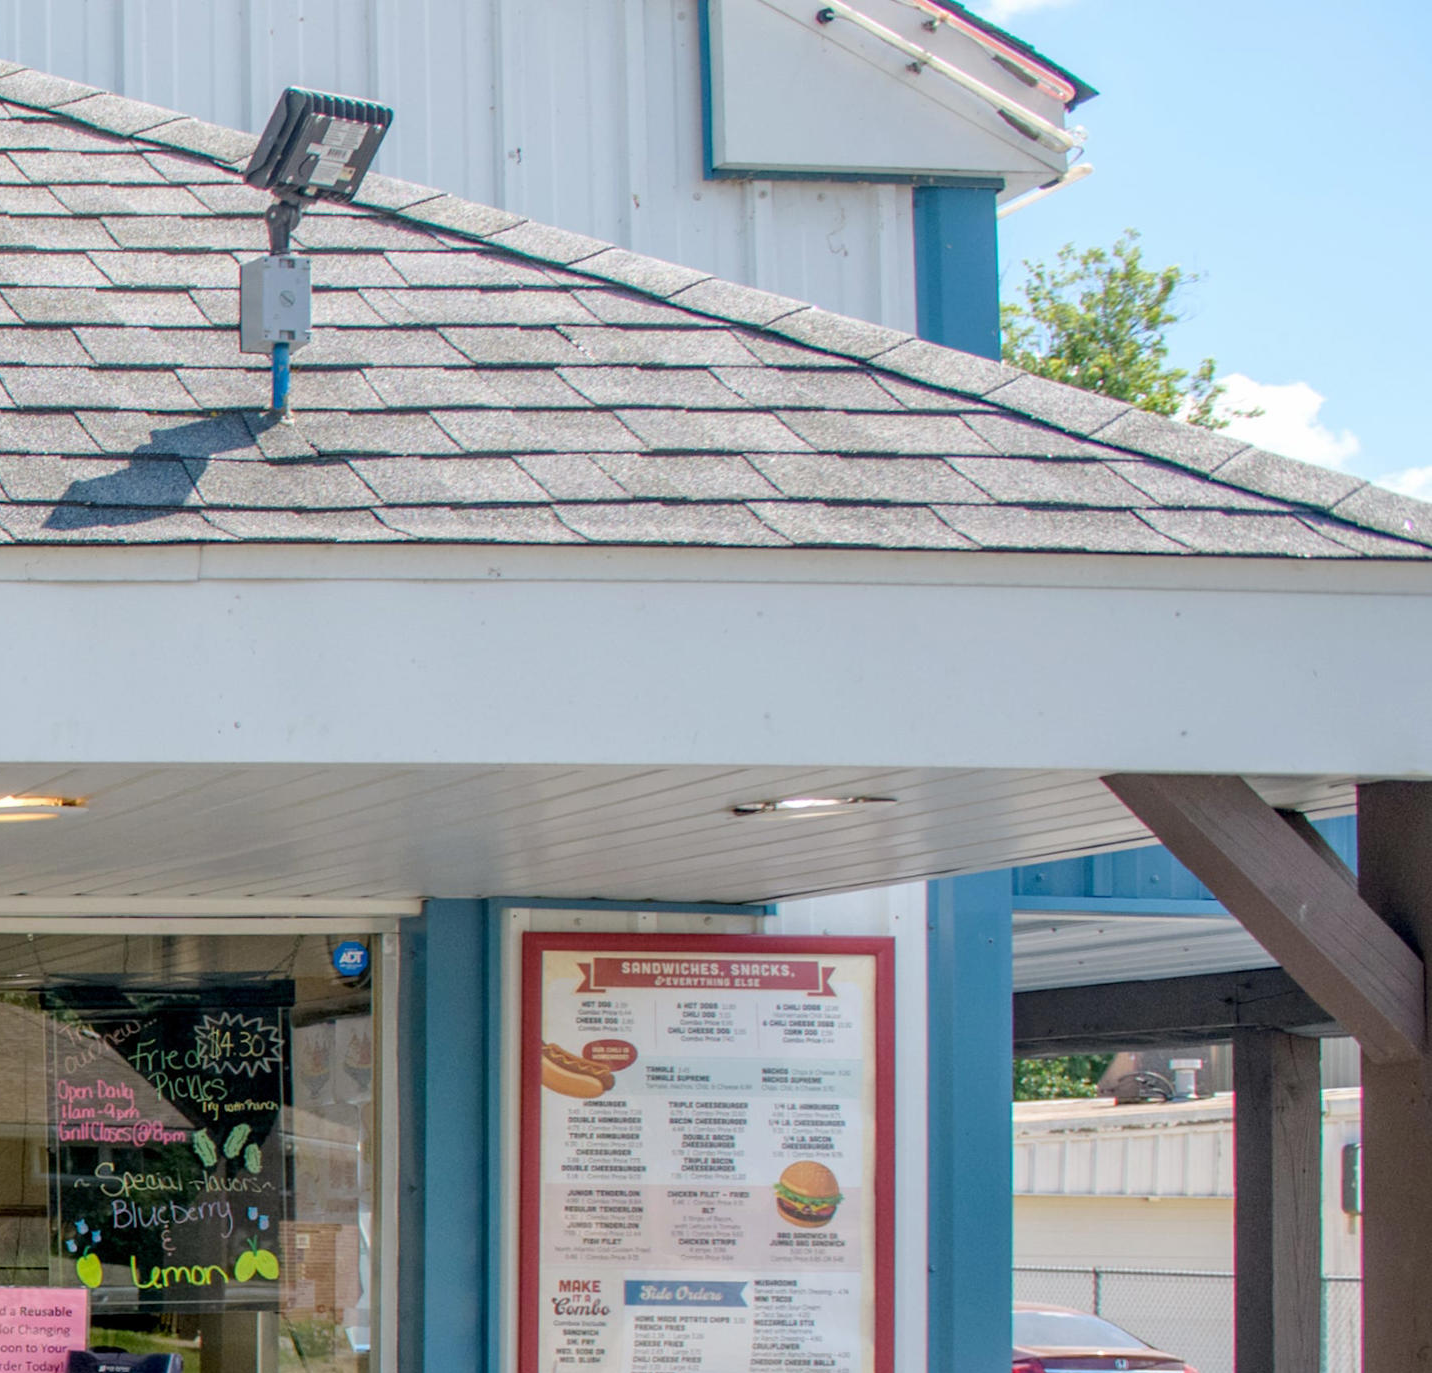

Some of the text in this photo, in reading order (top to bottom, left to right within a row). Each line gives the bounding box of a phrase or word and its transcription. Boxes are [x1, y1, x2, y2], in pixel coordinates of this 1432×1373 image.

[339, 951, 364, 963] ADT
[733, 976, 761, 988] ELSE
[209, 1026, 266, 1061] $4.30
[128, 1038, 201, 1072] Fried
[57, 1079, 135, 1110] Open Daily
[147, 1071, 228, 1102] Pickles
[58, 1120, 88, 1142] Grill
[94, 1161, 183, 1197] Special
[112, 1199, 234, 1240] Blueberry
[558, 1279, 602, 1293] MAKE
[640, 1285, 724, 1302] Side Orders
[9, 1308, 17, 1317] a
[19, 1306, 73, 1318] Reusable
[552, 1296, 611, 1317] Combo
[17, 1324, 71, 1338] Changing
[26, 1342, 38, 1353] to
[41, 1343, 68, 1354] Your
[25, 1361, 65, 1373] Today!
